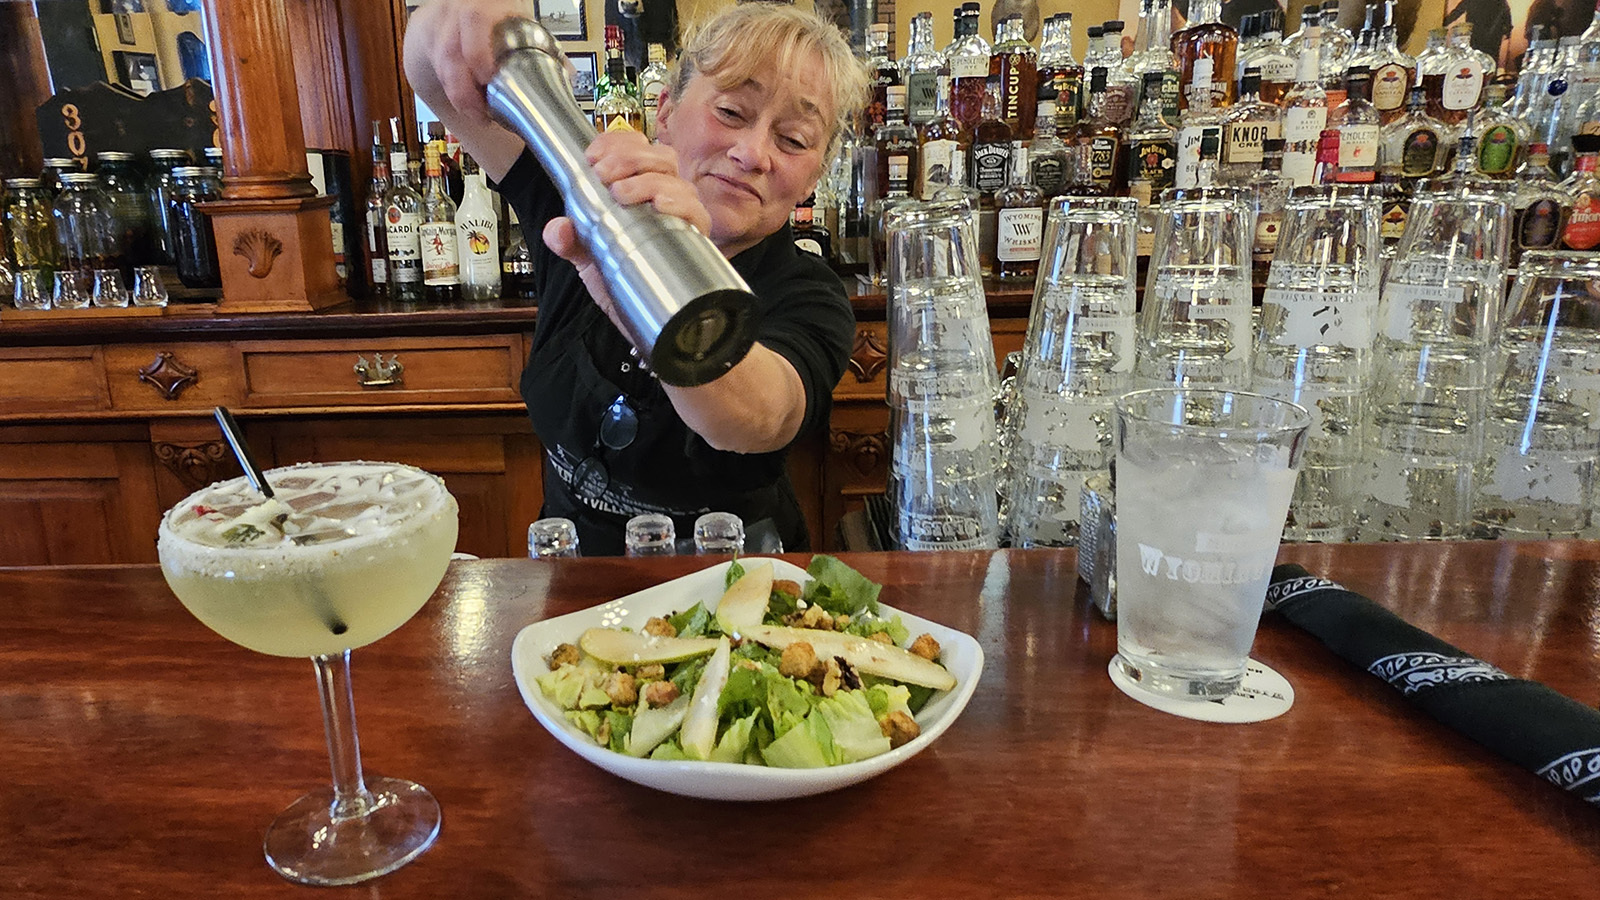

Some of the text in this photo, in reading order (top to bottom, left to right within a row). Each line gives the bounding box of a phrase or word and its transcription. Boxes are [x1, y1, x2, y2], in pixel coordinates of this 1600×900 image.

[1007, 66, 1020, 118] TINCUP
[1232, 126, 1268, 142] KNOB
[1184, 135, 1200, 149] JIM
[974, 148, 988, 160] JACK
[1003, 213, 1042, 223] WYOMING
[386, 223, 413, 234] CARDÍ
[460, 219, 496, 232] MALIBU
[1004, 235, 1040, 246] WHISKEY
